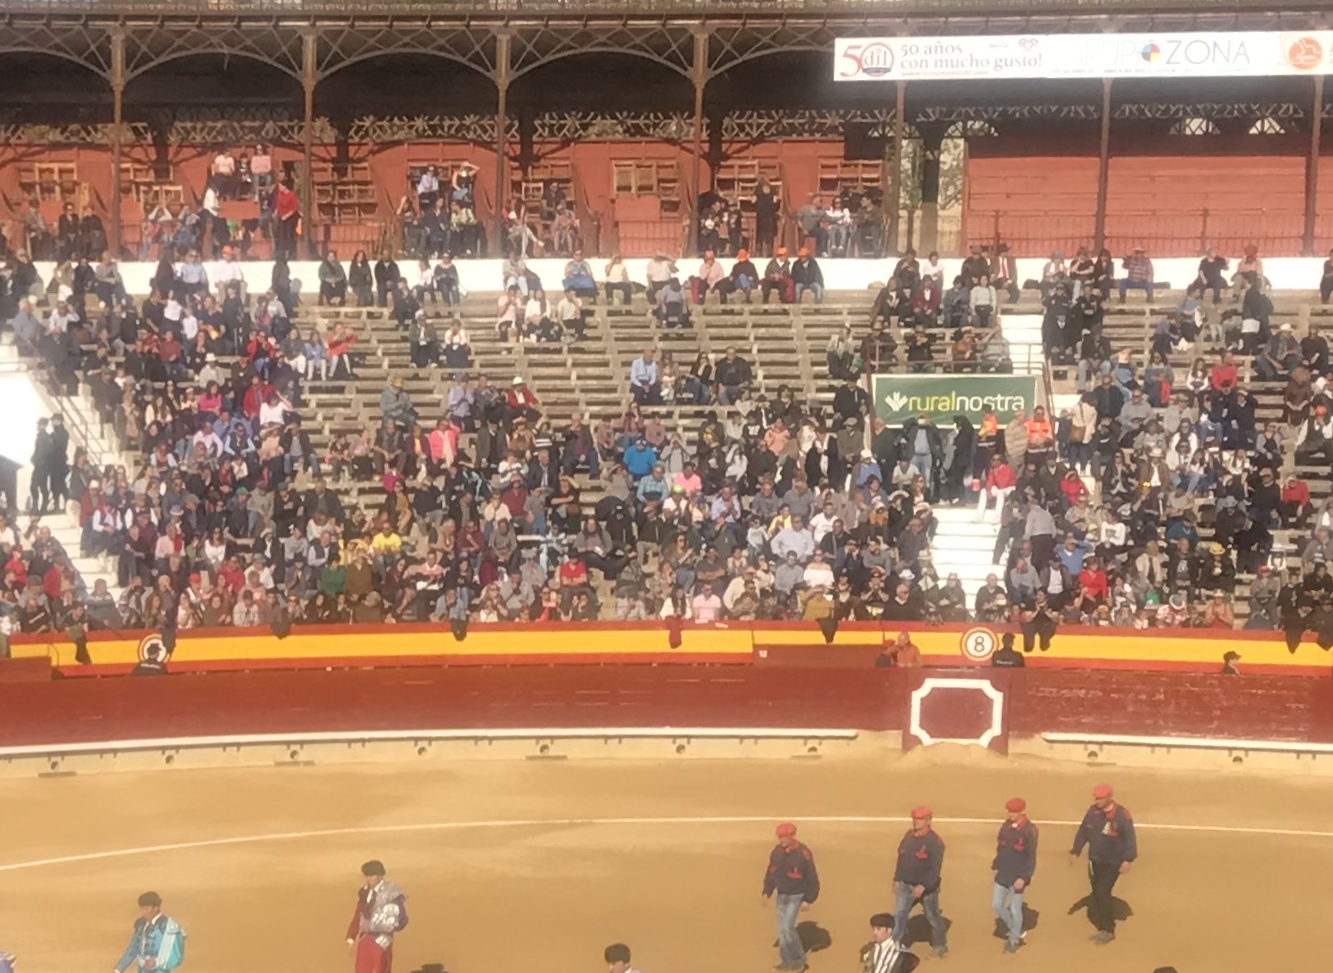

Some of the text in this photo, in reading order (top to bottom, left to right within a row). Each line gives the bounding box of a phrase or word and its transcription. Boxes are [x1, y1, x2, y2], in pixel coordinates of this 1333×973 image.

[900, 41, 963, 58] 50 años
[1165, 39, 1251, 65] ZONA
[900, 53, 1043, 72] con mucho gusto!
[908, 391, 1025, 413] ruralnostra
[974, 635, 985, 653] 8
